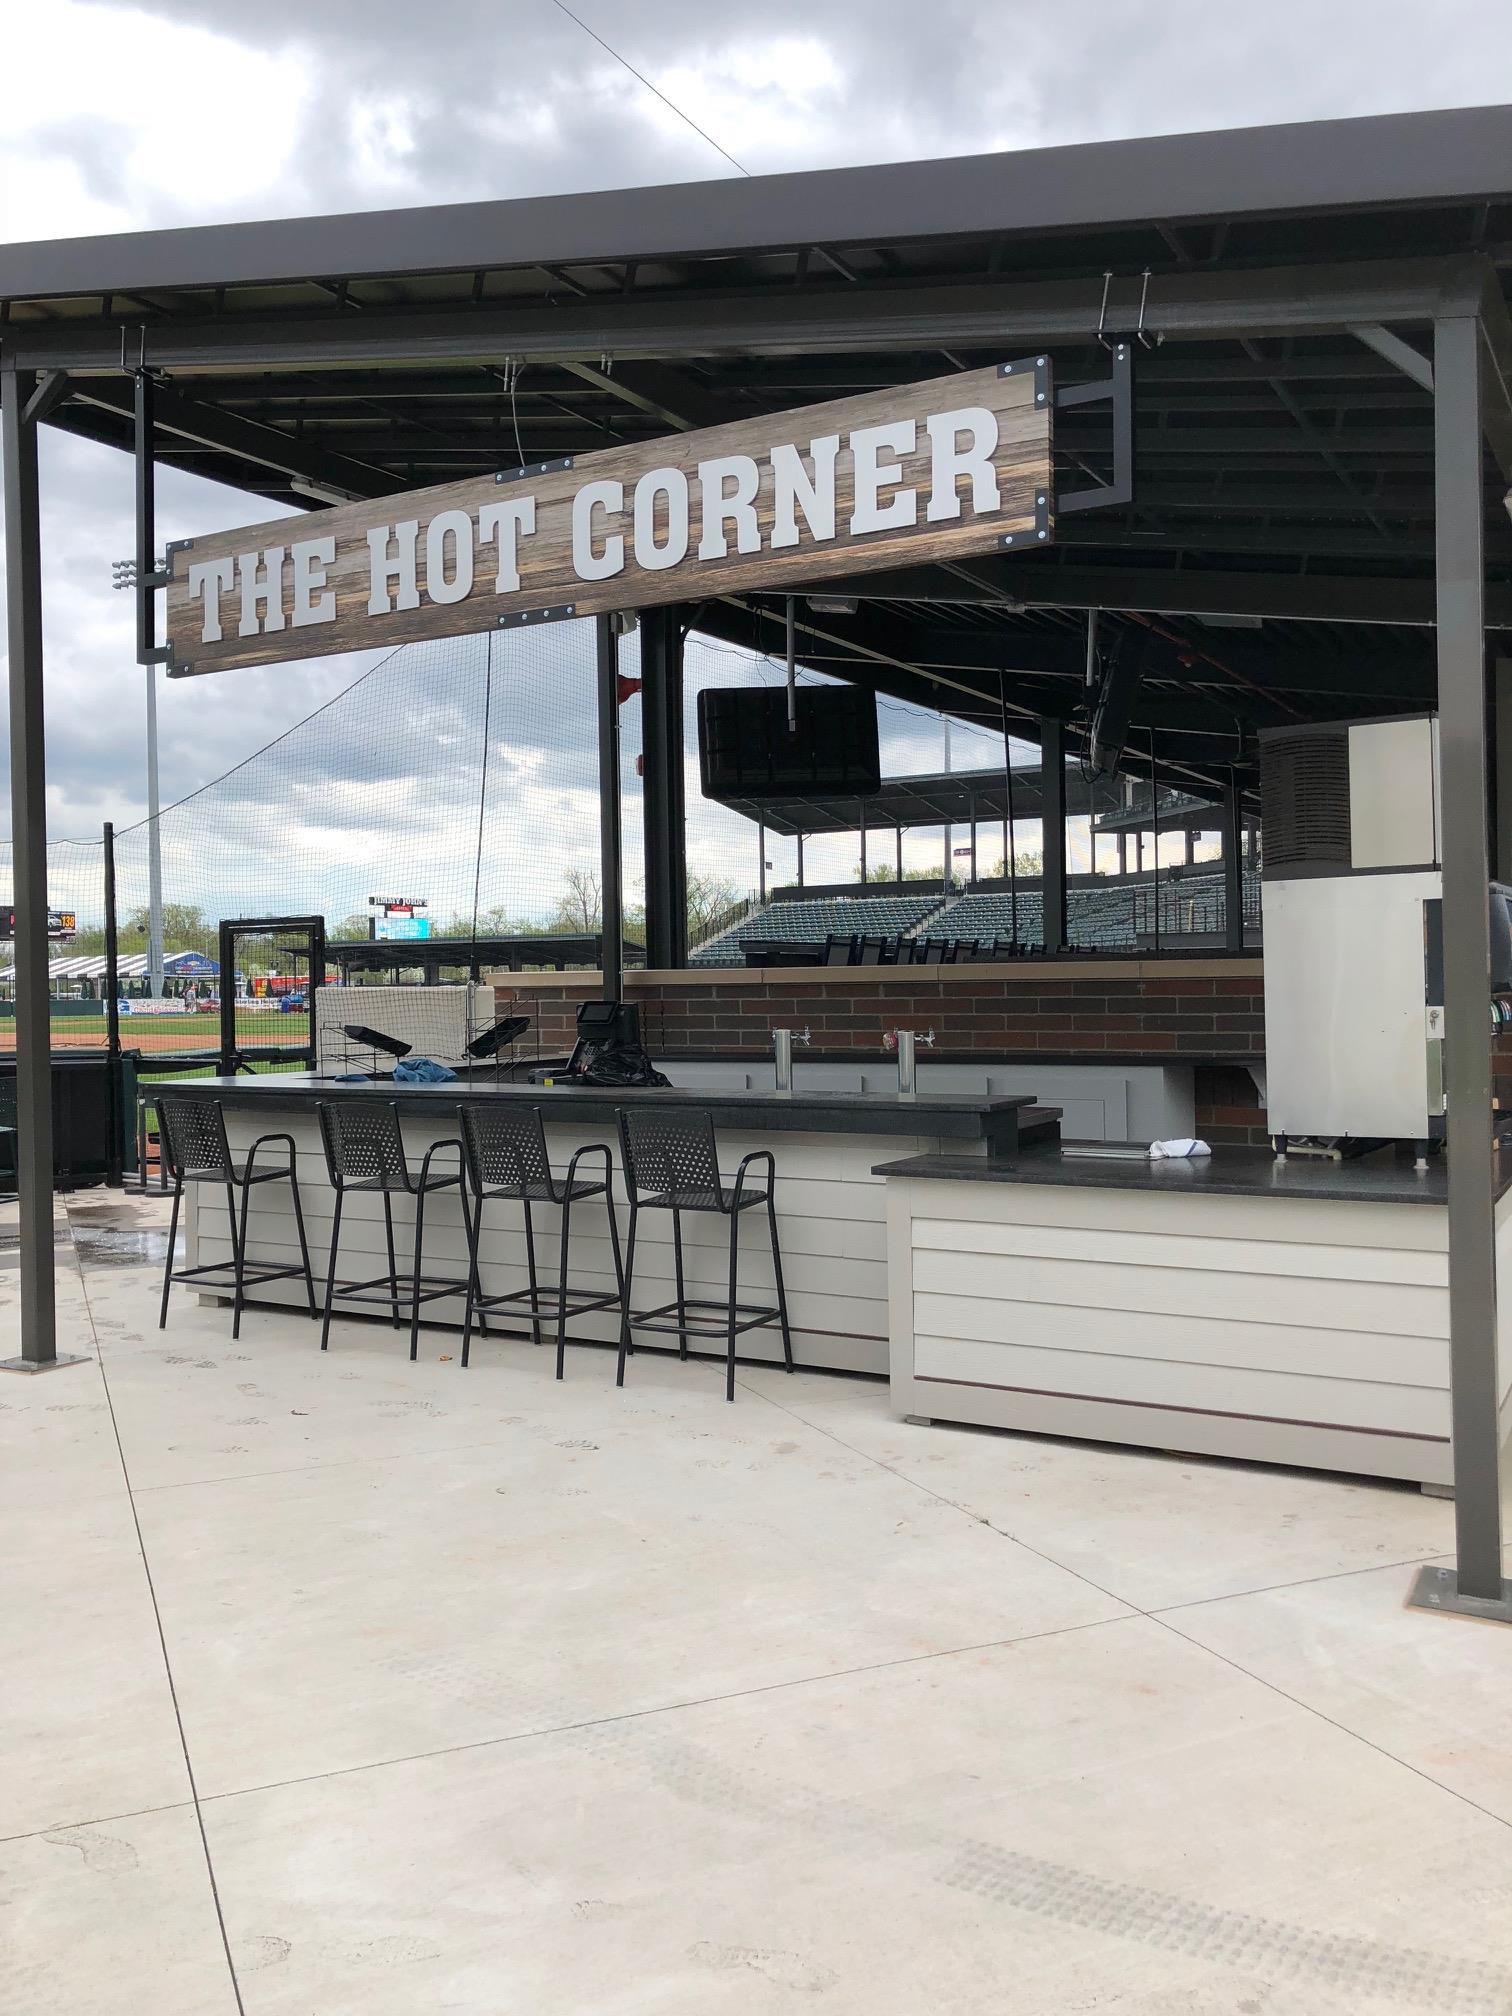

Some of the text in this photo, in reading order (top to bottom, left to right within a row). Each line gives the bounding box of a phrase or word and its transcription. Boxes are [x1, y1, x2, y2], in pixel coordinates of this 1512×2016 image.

[190, 407, 1003, 643] THE HOT CORNER
